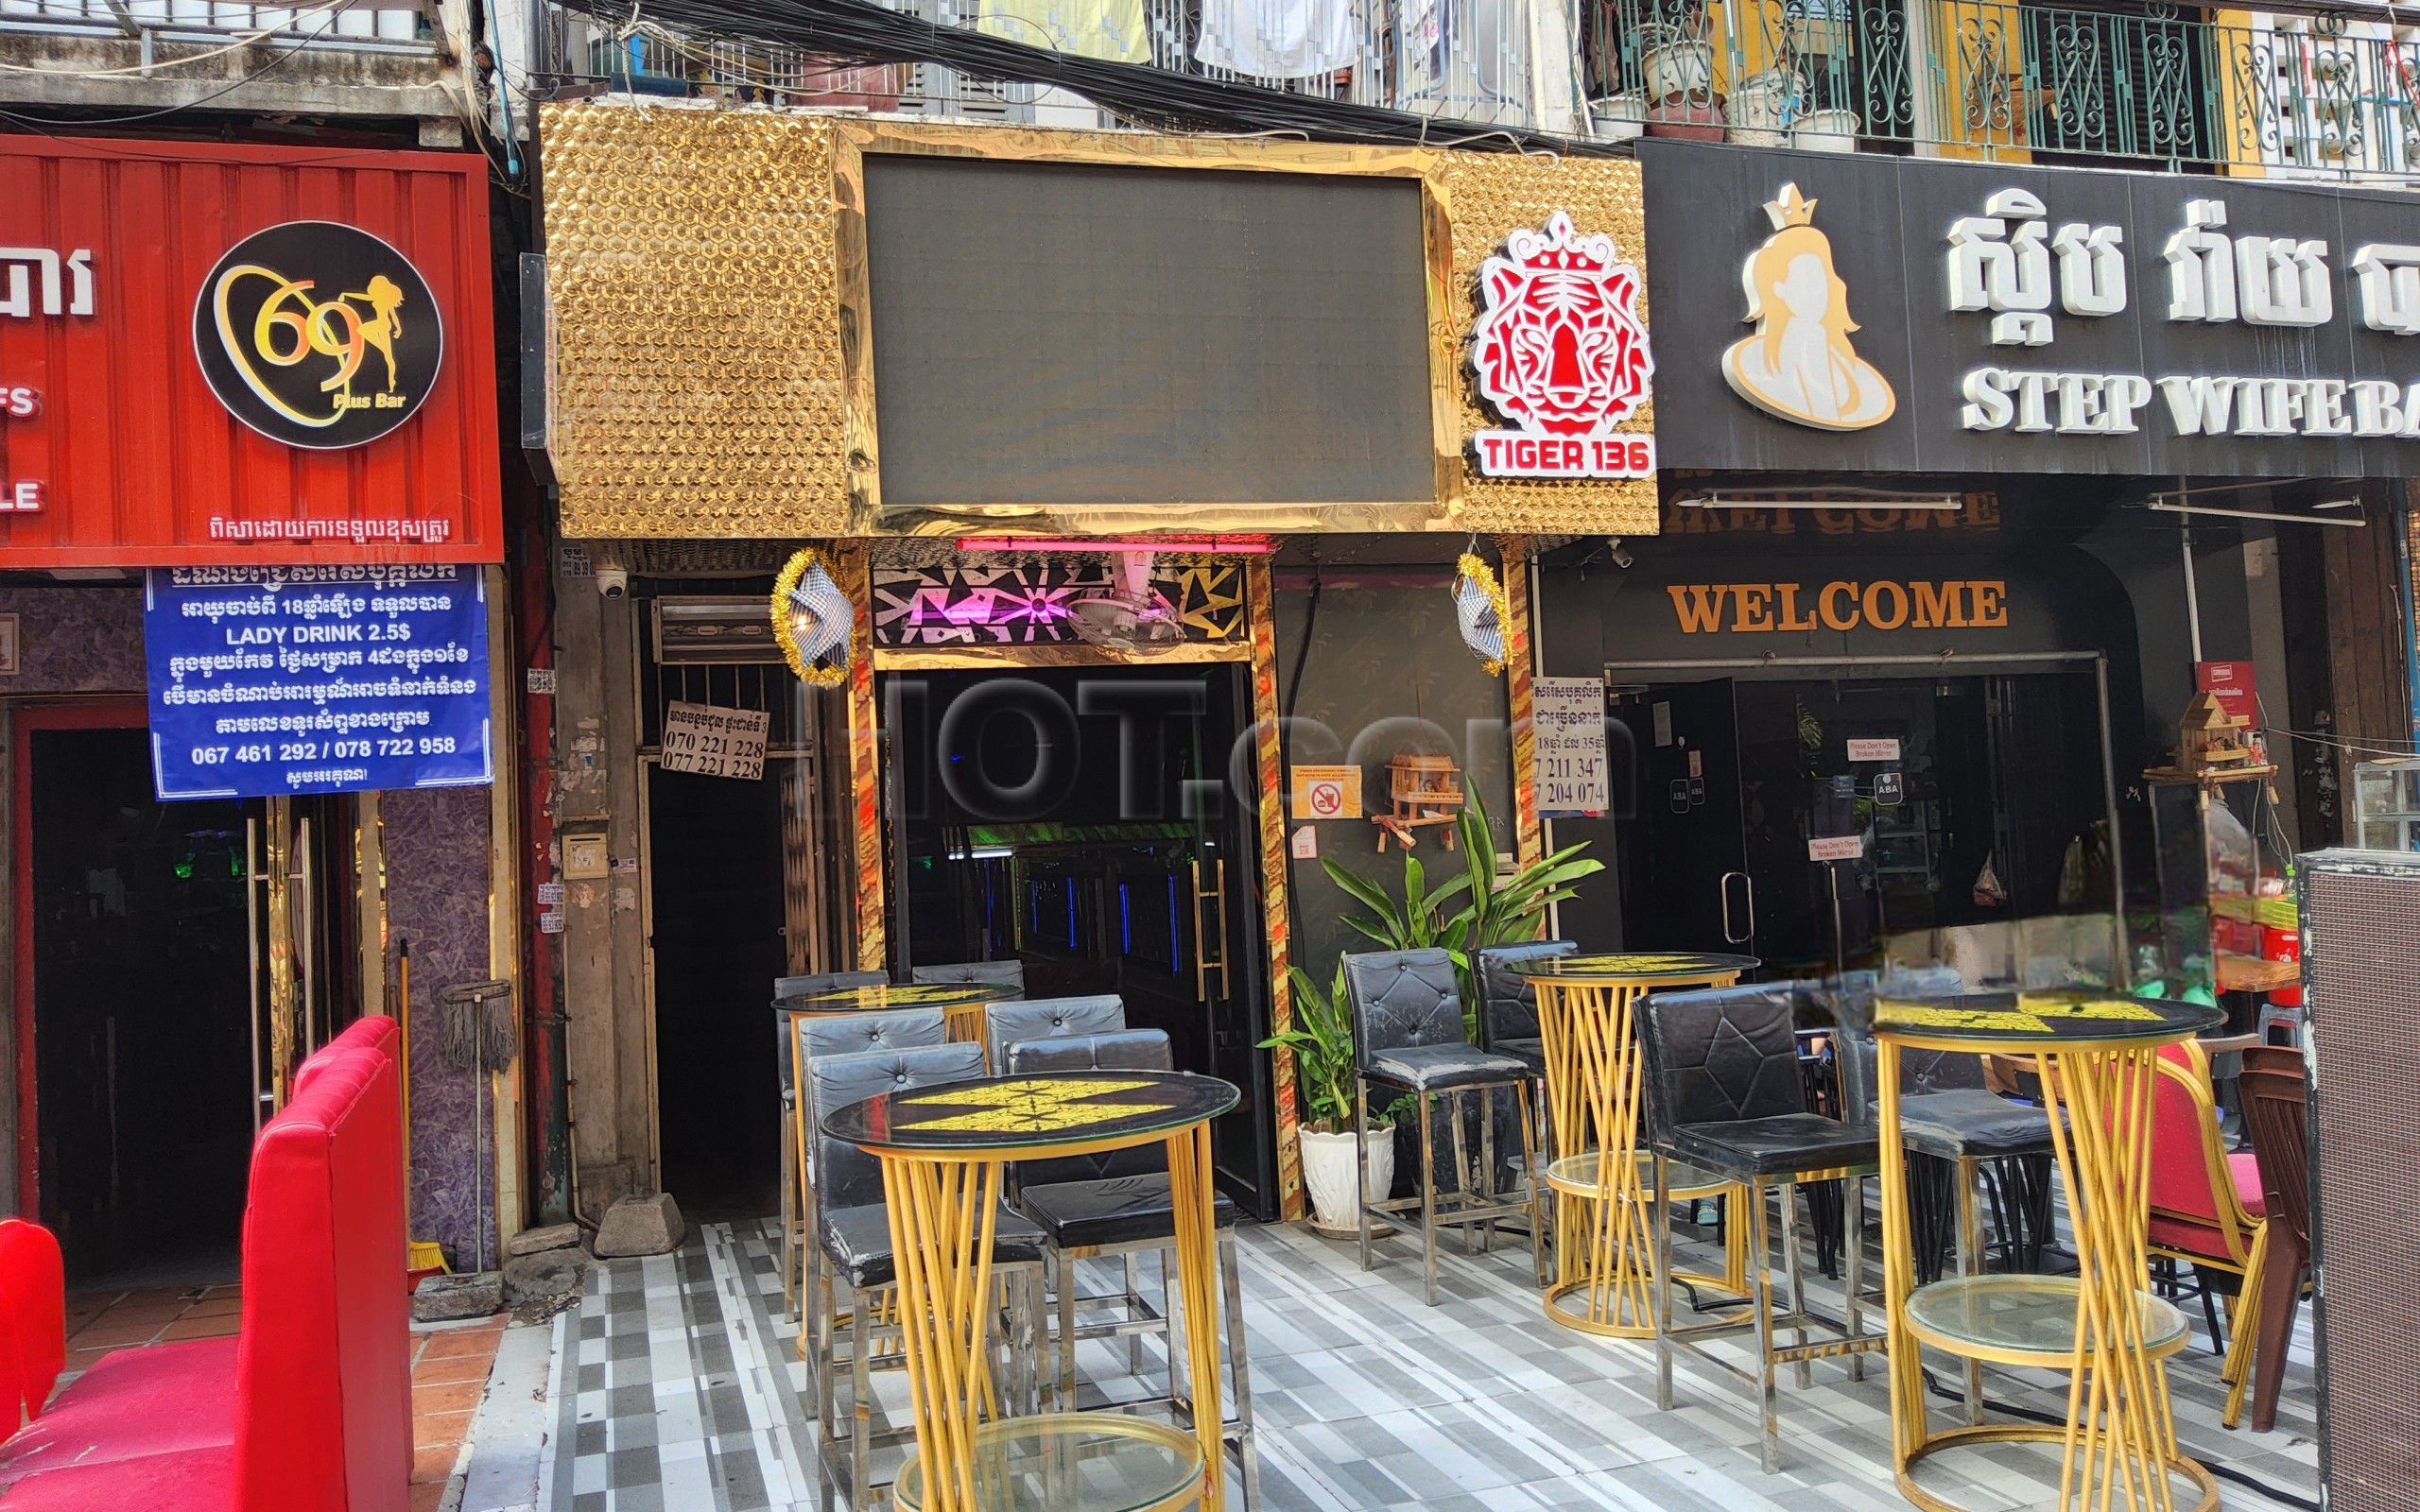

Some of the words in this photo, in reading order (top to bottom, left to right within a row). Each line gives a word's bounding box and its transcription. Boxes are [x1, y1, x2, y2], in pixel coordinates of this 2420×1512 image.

[333, 393, 371, 408] Plus
[375, 393, 406, 408] Bar
[1962, 367, 2152, 435] STEP
[2156, 374, 2352, 437] WIFE
[1482, 438, 1584, 471] TIGER
[1591, 440, 1650, 471] 136
[1667, 580, 2008, 633] WELCOME
[226, 627, 287, 645] LADY
[293, 625, 363, 644] DRINK
[368, 623, 412, 642] 2.5$
[191, 747, 229, 765] 067
[234, 746, 271, 764] 461
[279, 744, 317, 762] 292
[322, 742, 329, 760] /
[335, 741, 372, 760] 078
[377, 739, 414, 757] 722
[420, 737, 456, 755] 958
[666, 731, 696, 750] 070
[700, 736, 729, 755] 221
[734, 740, 764, 759] 228
[664, 751, 693, 770] 077
[698, 756, 725, 776] 221
[731, 761, 761, 779] 228
[1547, 758, 1571, 778] 211
[1577, 758, 1602, 778] 347
[1547, 782, 1572, 803] 204
[1578, 782, 1604, 803] 074
[1878, 785, 1898, 794] ABA
